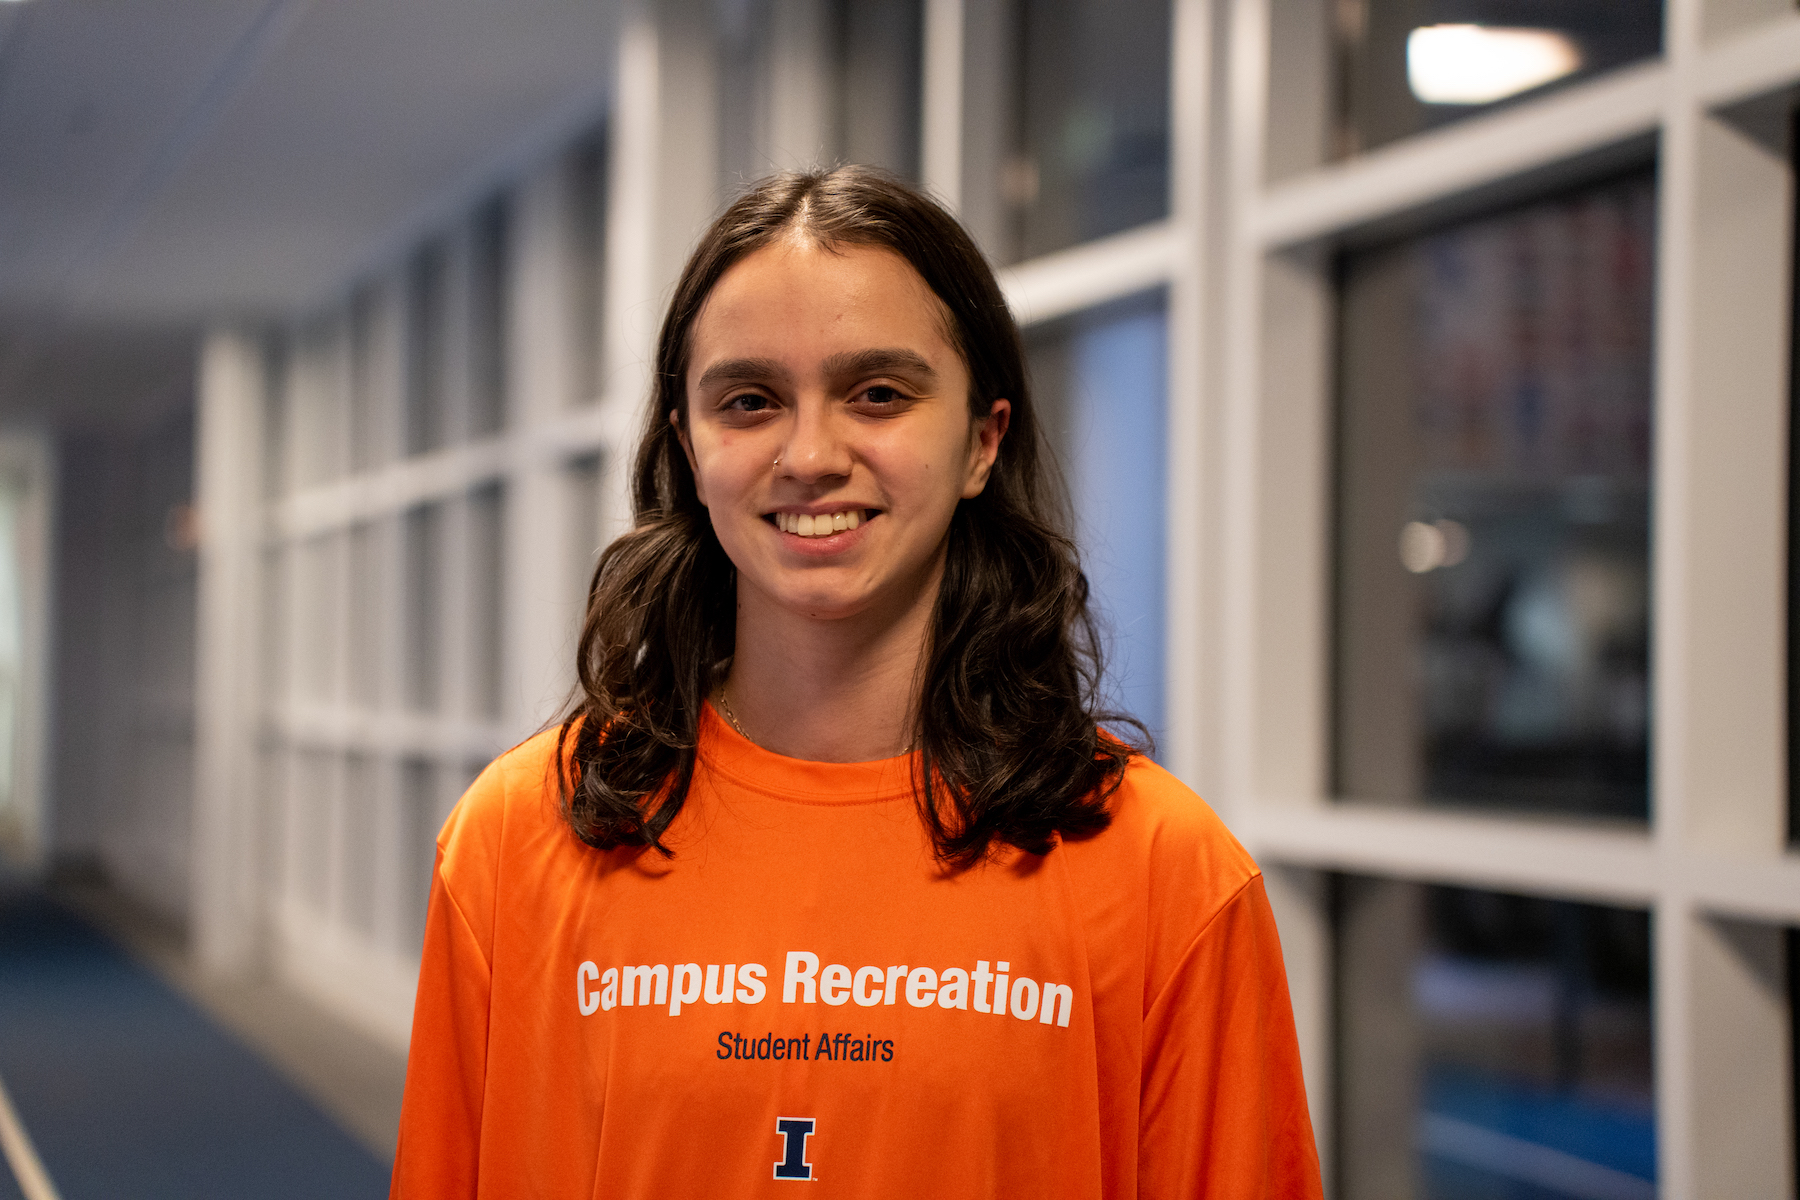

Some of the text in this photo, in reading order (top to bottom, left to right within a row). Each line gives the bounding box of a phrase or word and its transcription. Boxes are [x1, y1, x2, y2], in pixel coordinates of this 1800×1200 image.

[576, 950, 1073, 1028] Campus Recreation
[716, 1031, 894, 1063] Student Affairs
[773, 1116, 816, 1181] I
